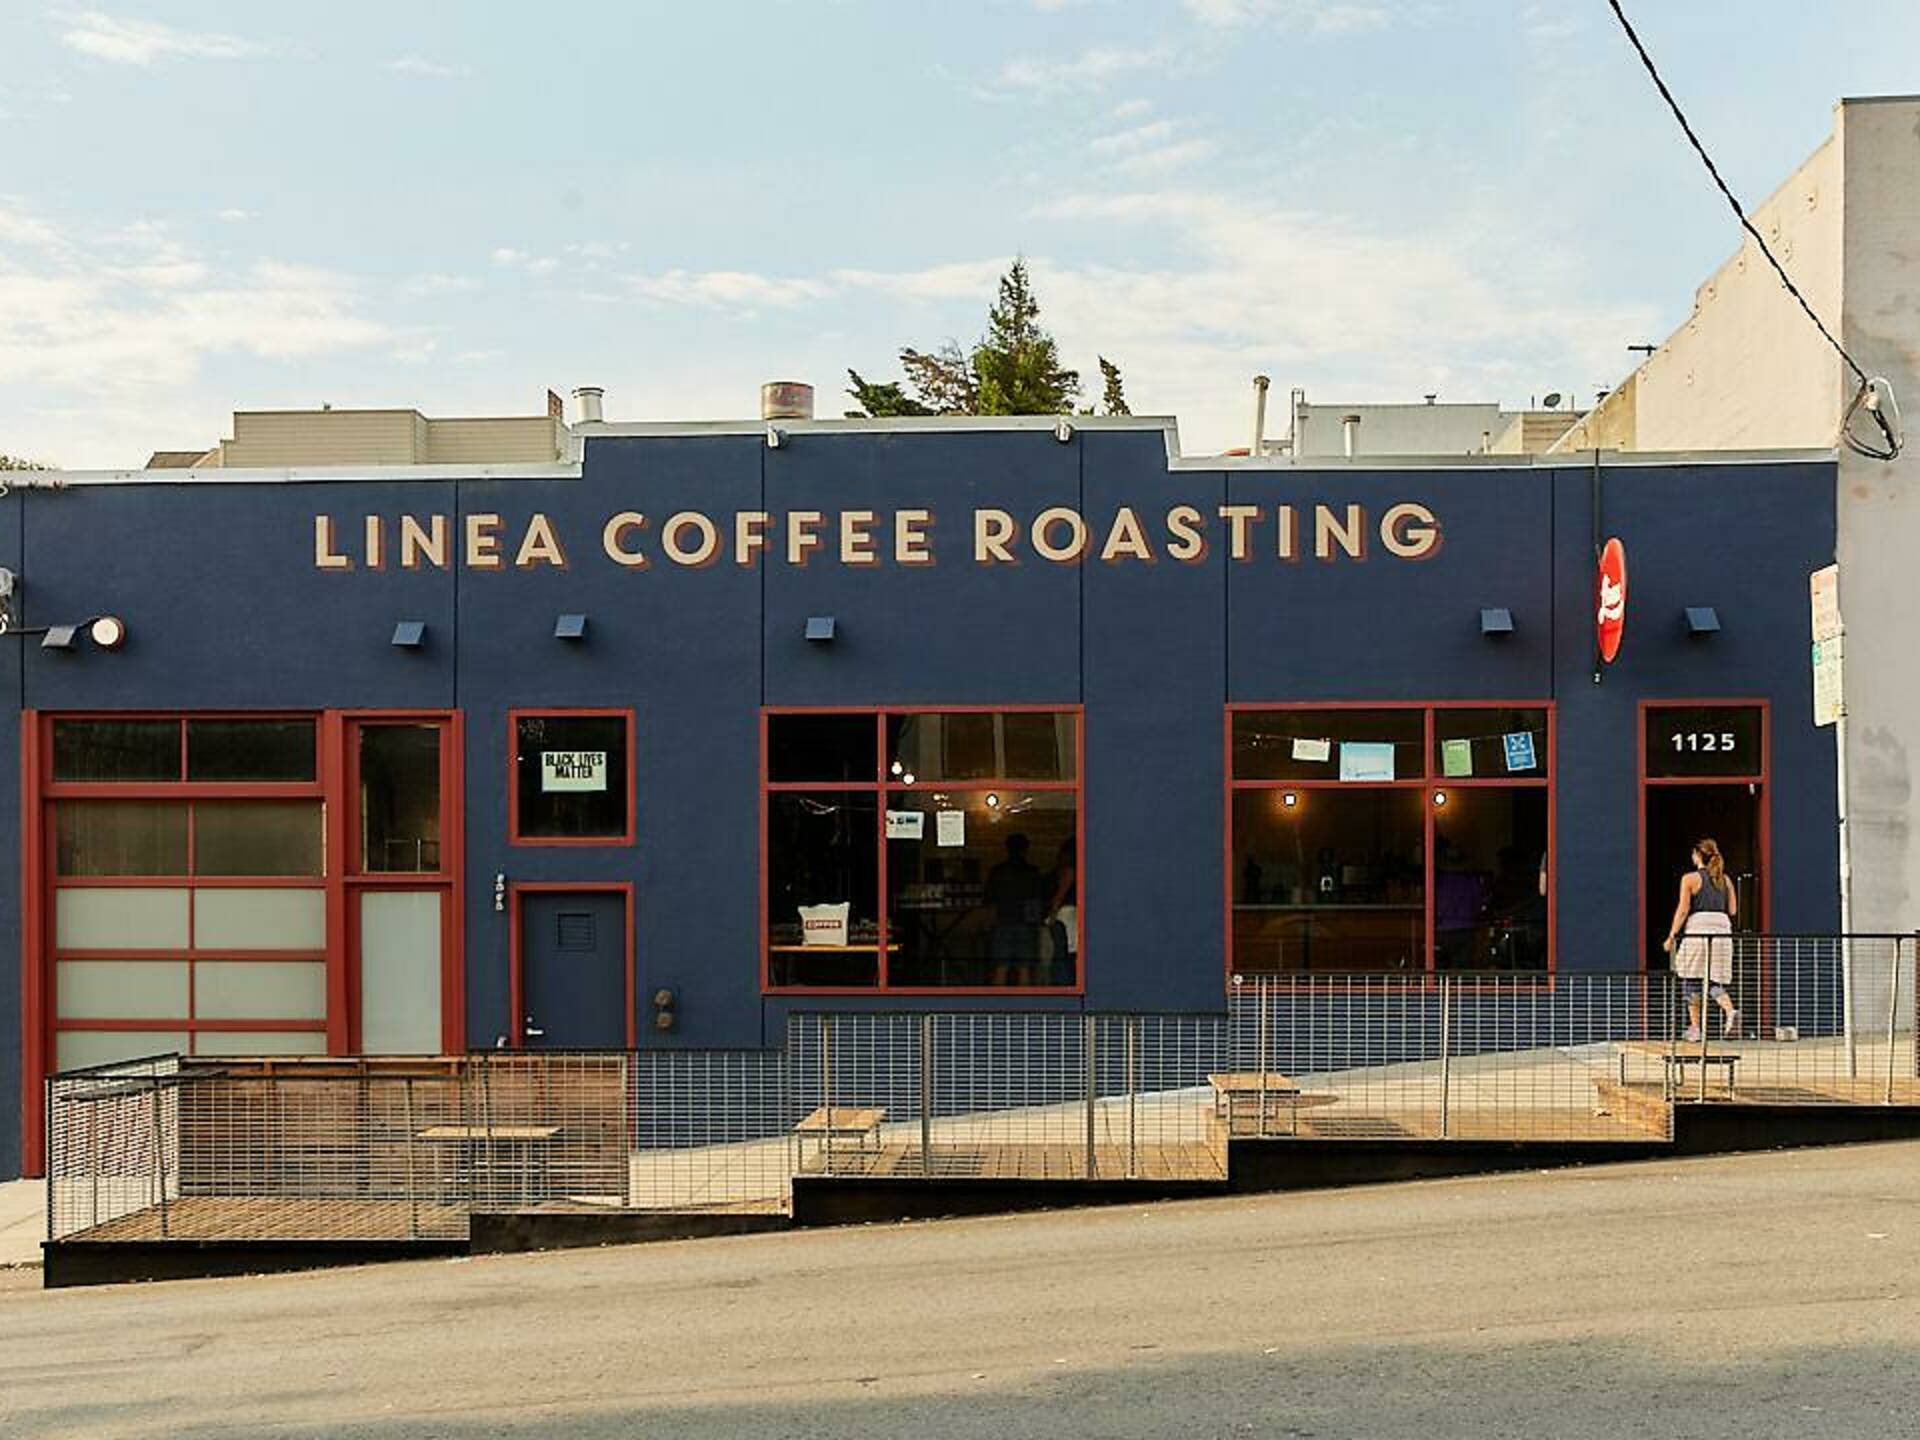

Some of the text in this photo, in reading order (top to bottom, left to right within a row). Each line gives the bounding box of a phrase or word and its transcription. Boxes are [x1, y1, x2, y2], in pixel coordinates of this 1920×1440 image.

[314, 502, 1442, 571] LINEA COFFEE ROASTING
[1671, 732, 1736, 752] 1125
[545, 753, 603, 767] BLACK LIVES
[555, 765, 593, 779] MATTER
